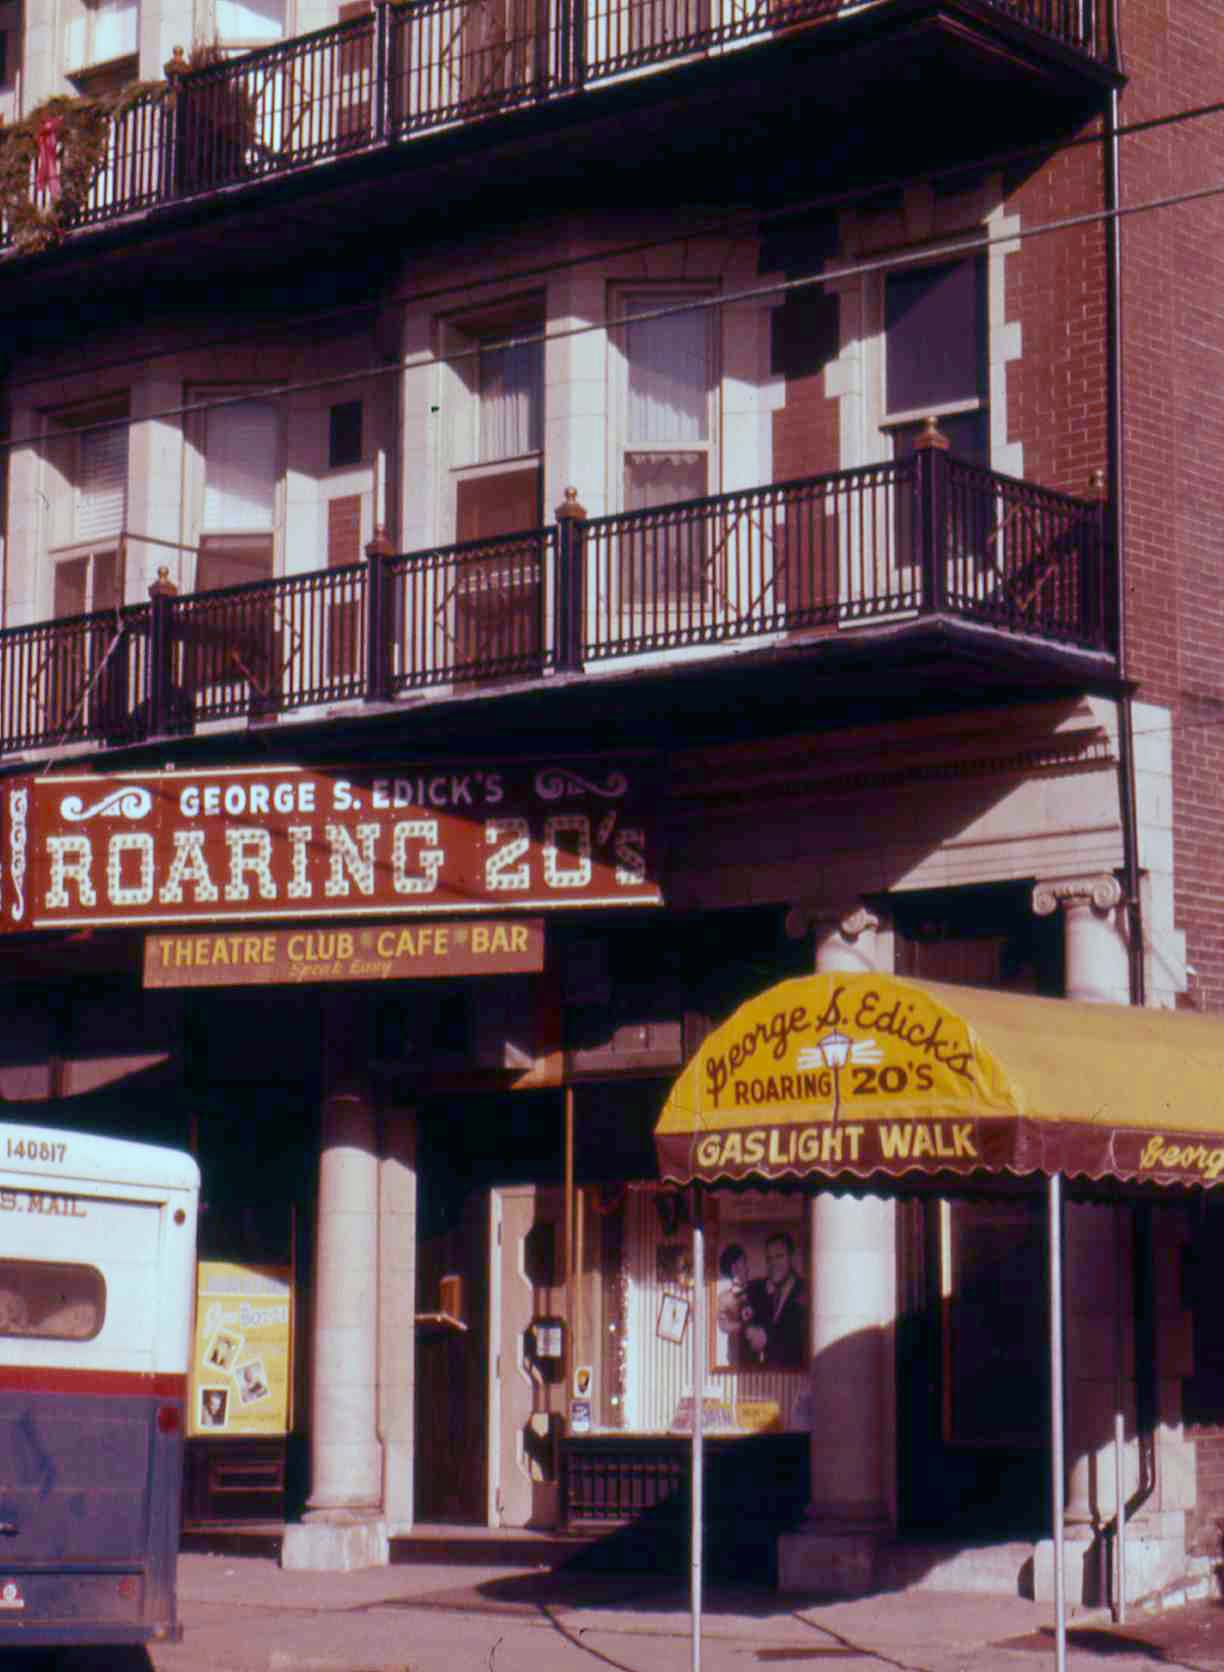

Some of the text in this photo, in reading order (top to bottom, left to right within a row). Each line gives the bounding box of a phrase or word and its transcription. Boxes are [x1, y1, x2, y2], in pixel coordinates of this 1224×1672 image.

[179, 771, 504, 817] GEORGE S. EDICK'S
[45, 819, 444, 909] ROARING
[160, 924, 528, 966] THEATRE CLUB CAFE BAR
[706, 1007, 811, 1108] George
[855, 991, 976, 1083] Edick's
[735, 1061, 933, 1105] ROARING 20'S
[697, 1123, 977, 1168] GASLIGHT WALK
[27, 1195, 88, 1218] MAIL
